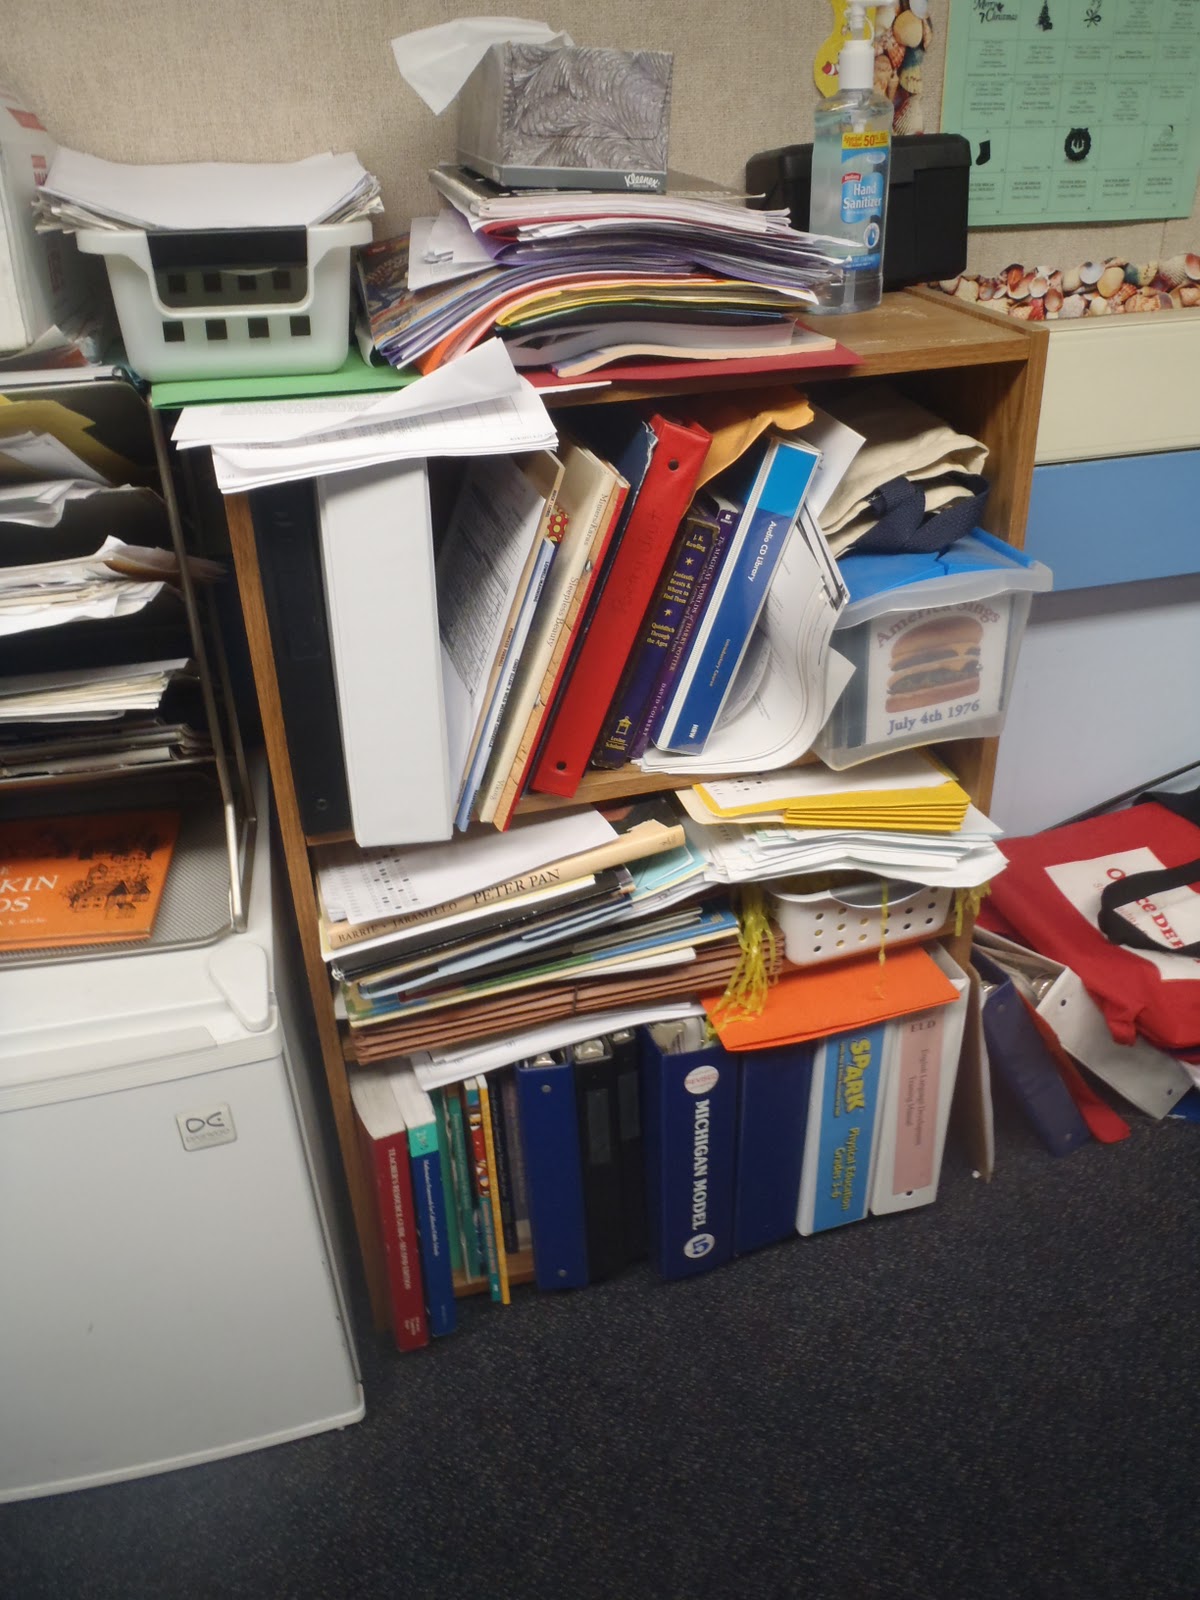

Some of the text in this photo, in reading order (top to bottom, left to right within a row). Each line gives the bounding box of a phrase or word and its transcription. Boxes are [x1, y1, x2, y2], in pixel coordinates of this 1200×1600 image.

[624, 172, 660, 188] Kleenex
[853, 183, 876, 196] Hand
[843, 197, 882, 210] Sanitizer
[705, 546, 721, 582] MAGICAL
[747, 520, 777, 582] Audio CD Library
[547, 576, 578, 647] Sleepless Beauty
[691, 582, 707, 614] WORLDS
[650, 630, 670, 640] Through
[679, 621, 692, 645] HARRY
[668, 645, 682, 672] POTTER
[642, 683, 667, 736] DAVID COLBERT
[887, 699, 980, 735] July 4th 1976
[473, 868, 561, 904] PETER PAN
[392, 901, 458, 928] JARAMILLO
[845, 1038, 871, 1115] SPARK
[692, 1098, 710, 1231] MICHIGAN MODEL
[834, 1146, 846, 1183] Grades
[842, 1127, 860, 1210] Physical Education
